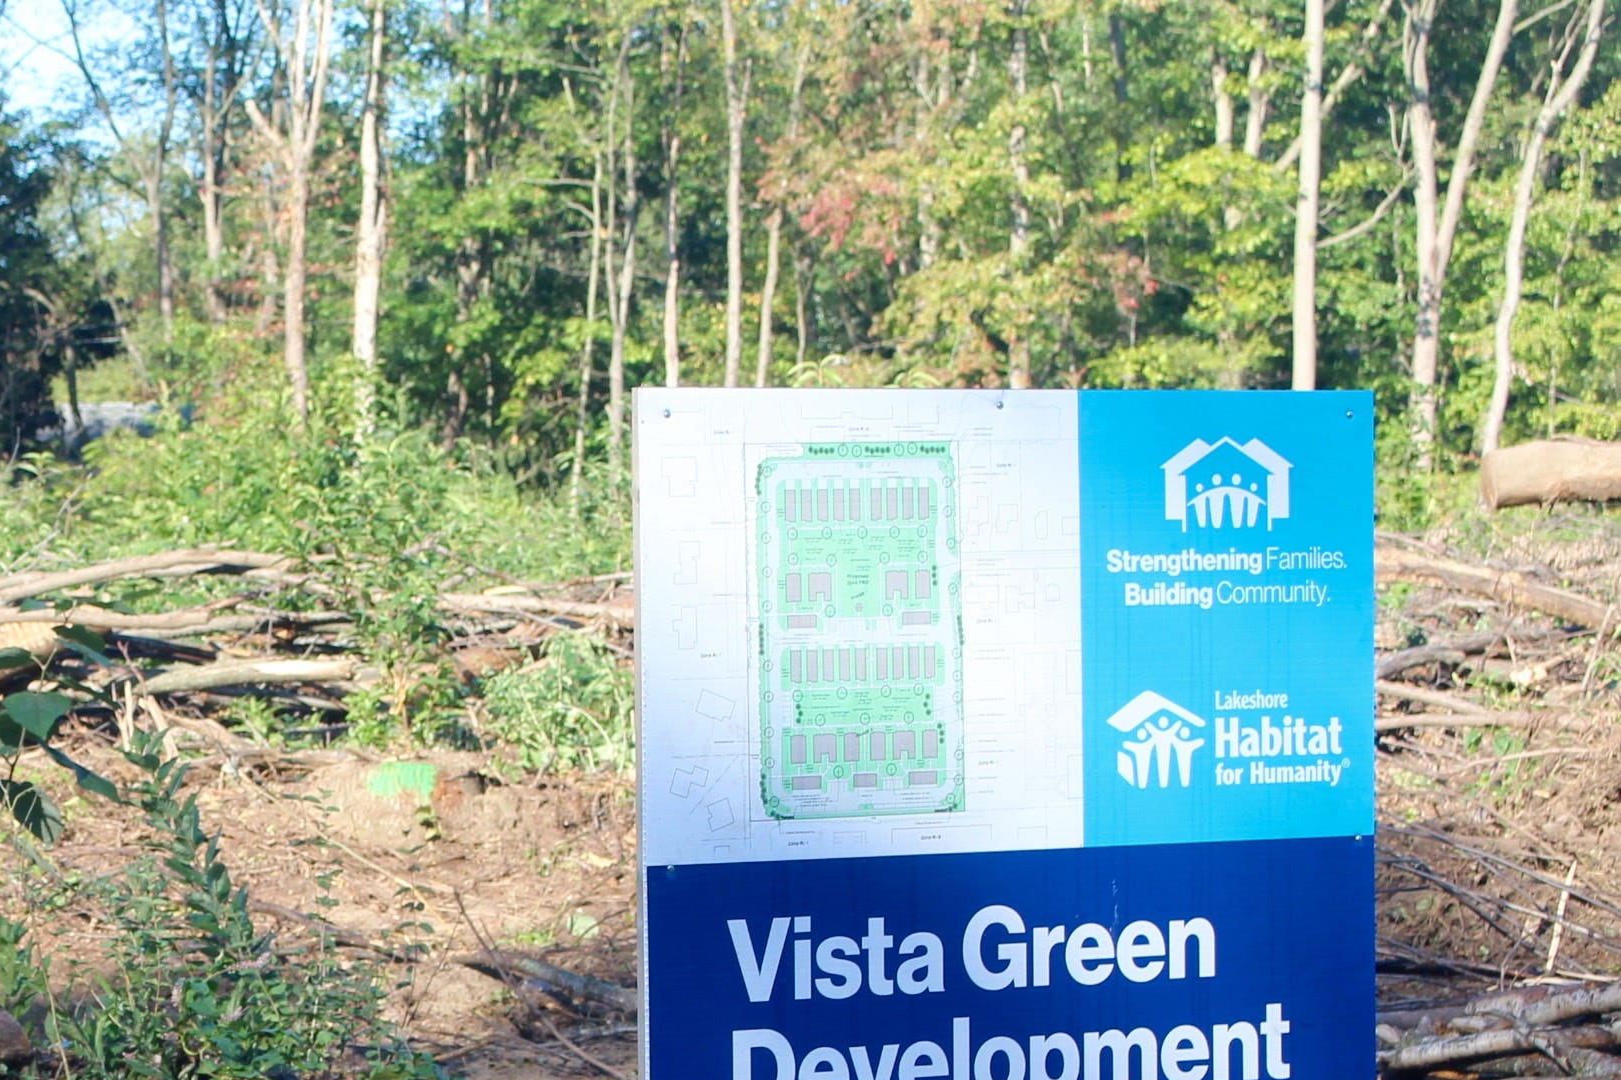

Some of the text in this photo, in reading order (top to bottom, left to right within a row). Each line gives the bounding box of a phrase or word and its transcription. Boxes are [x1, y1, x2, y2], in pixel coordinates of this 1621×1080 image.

[1107, 547, 1347, 576] Strengthening Families.
[1125, 580, 1331, 609] Building Community.
[1215, 690, 1288, 710] Lakeshore
[1215, 716, 1342, 758] Habitat
[1216, 762, 1243, 785] for
[727, 904, 1216, 1003] Vista Green
